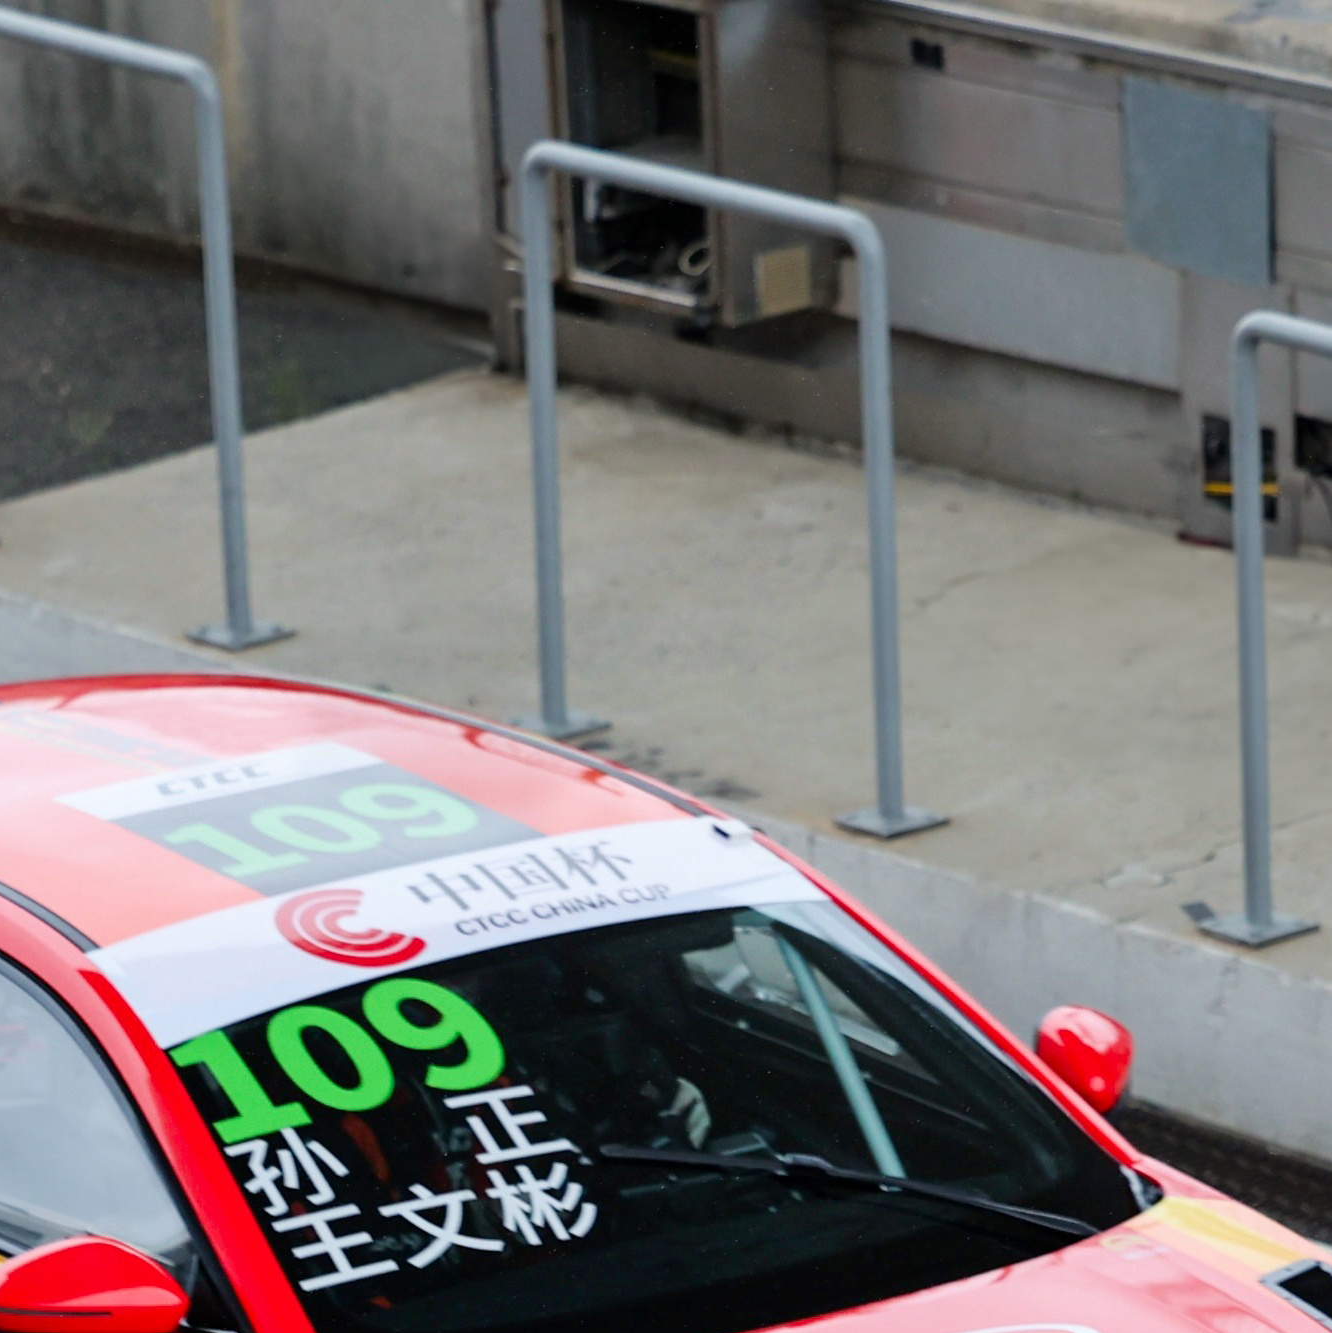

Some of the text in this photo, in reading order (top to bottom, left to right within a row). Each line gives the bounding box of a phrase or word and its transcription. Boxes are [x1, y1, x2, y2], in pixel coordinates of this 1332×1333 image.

[157, 764, 268, 797] CTCC
[164, 783, 478, 878] 109
[408, 842, 632, 911] 中国杯
[456, 883, 672, 937] CTCC CHINA CUP
[169, 977, 506, 1144] 109
[271, 1163, 598, 1292] 王文彬
